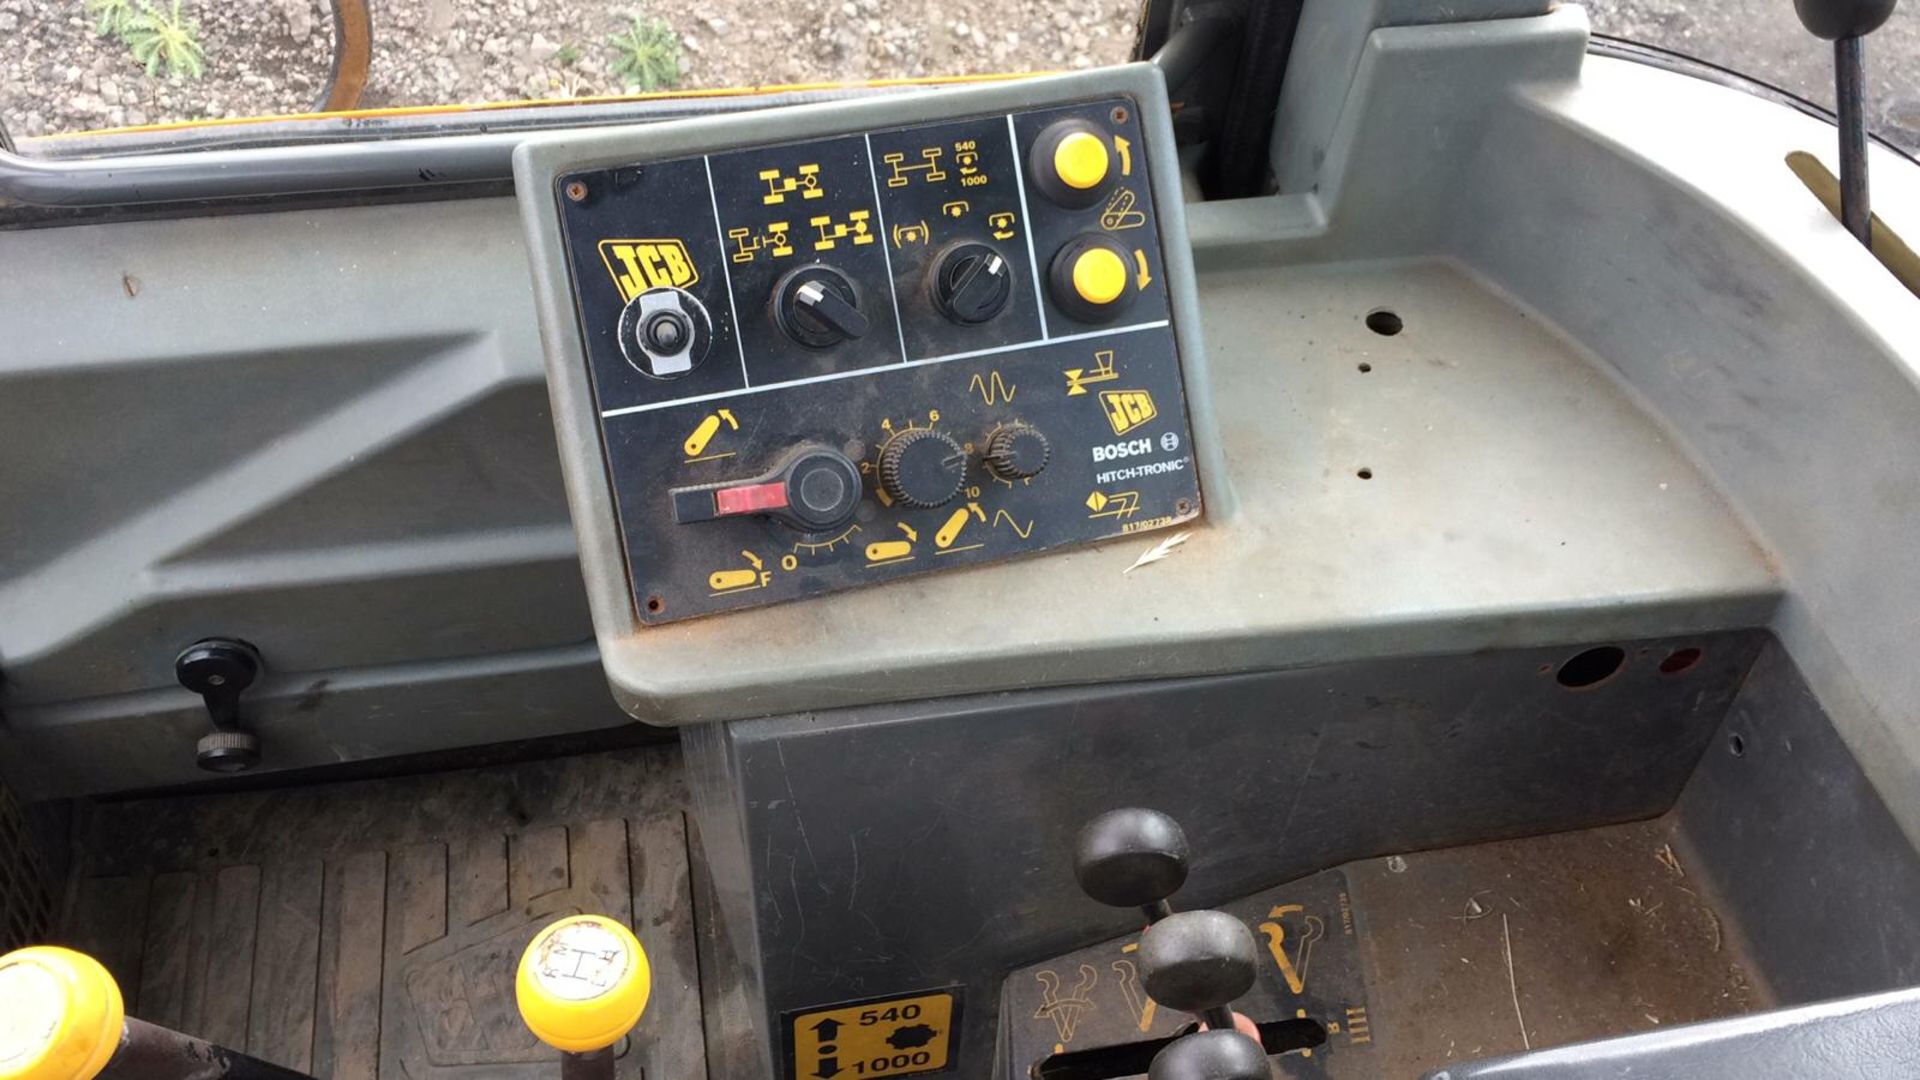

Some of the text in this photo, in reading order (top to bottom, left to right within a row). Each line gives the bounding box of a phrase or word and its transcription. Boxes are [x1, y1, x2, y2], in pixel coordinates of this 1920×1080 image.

[955, 141, 976, 152] 540
[960, 175, 987, 187] 1000
[612, 245, 692, 298] JCB
[929, 410, 940, 421] 6
[1107, 393, 1153, 431] JCB
[881, 418, 891, 429] 4
[1092, 438, 1152, 462] BOSCH
[861, 462, 871, 474] 2
[965, 486, 981, 498] 10
[760, 571, 772, 587] F
[859, 1004, 922, 1026] 540
[852, 1051, 931, 1074] 1000
